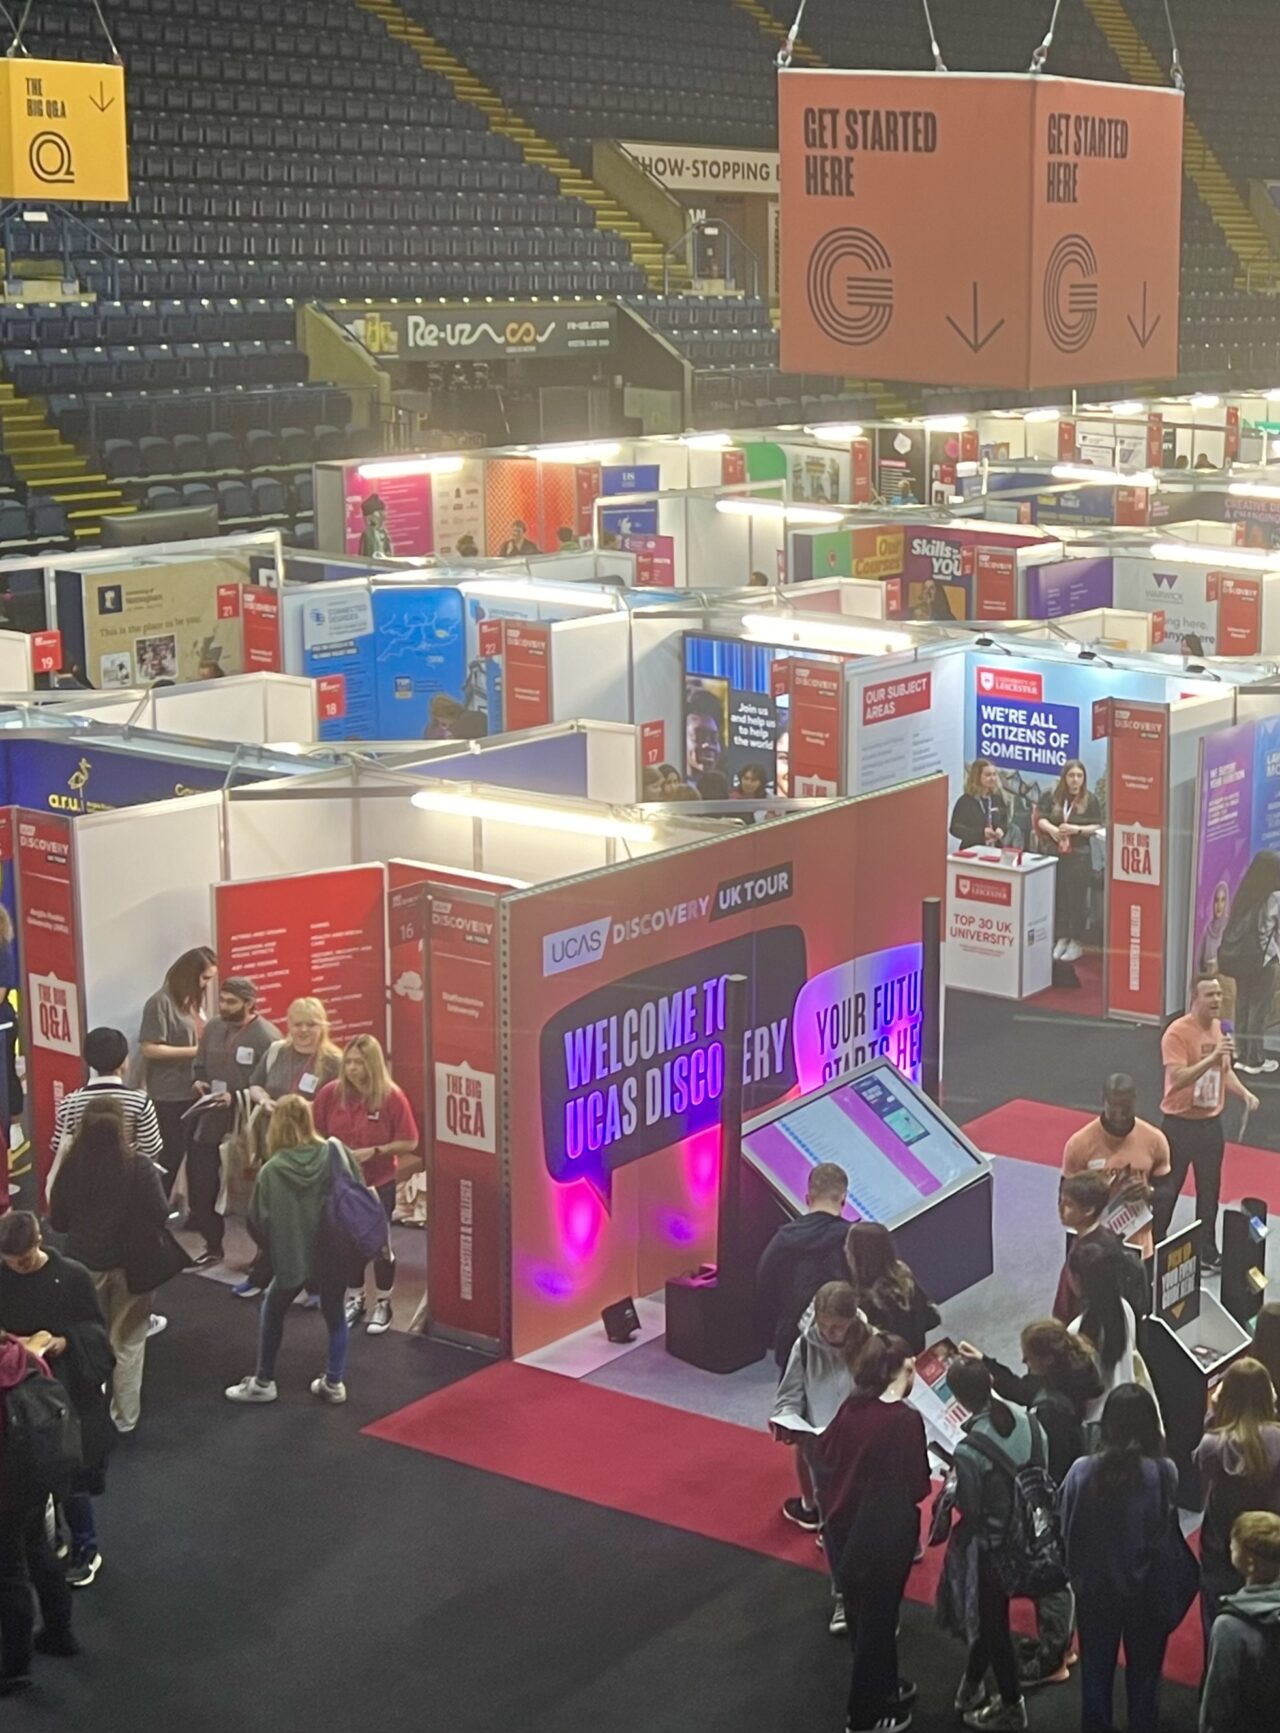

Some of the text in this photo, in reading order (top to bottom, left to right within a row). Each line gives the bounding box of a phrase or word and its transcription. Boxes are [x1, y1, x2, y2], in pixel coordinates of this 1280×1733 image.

[26, 77, 43, 96] THE
[27, 98, 66, 119] BIG Q&A
[803, 107, 937, 153] GET STARTED
[1048, 113, 1129, 159] GET STARTED
[805, 155, 855, 198] HERE
[1046, 162, 1079, 203] HERE
[807, 227, 893, 346] G
[1043, 234, 1098, 354] G
[1224, 498, 1268, 512] CREATIVE
[878, 538, 901, 557] Our
[911, 538, 952, 560] Skills
[855, 557, 901, 577] Courses
[932, 557, 962, 577] YOU
[1145, 589, 1184, 601] WARWICK
[99, 627, 118, 638] This
[128, 623, 142, 633] the
[142, 621, 164, 636] place
[41, 656, 54, 669] 19
[865, 677, 928, 705] OUR SUBJECT
[995, 682, 1038, 695] LEICESTER
[325, 703, 337, 716] 18
[738, 703, 769, 716] Join us
[865, 700, 896, 720] AREAS
[981, 705, 1058, 730] WE'RE ALL
[730, 712, 776, 729] and help us
[1114, 719, 1162, 732] DISCOVERY
[738, 725, 769, 740] to help
[981, 723, 1069, 749] CITIZENS OF
[733, 736, 774, 751] the world
[981, 740, 1067, 766] SOMETHING
[647, 749, 659, 763] 17
[20, 835, 69, 854] DISCOVERY
[1122, 830, 1150, 849] THE BIG
[1120, 846, 1152, 876] Q&A
[431, 912, 494, 937] DISCOVERY
[552, 871, 789, 964] UCAS DISCOVERY UK TOUR
[953, 913, 976, 927] TOP
[978, 918, 994, 930] 30
[996, 921, 1013, 934] UK
[399, 922, 415, 941] 16
[950, 926, 1015, 948] UNIVERSITY
[38, 982, 67, 1008] THE BIG
[39, 1007, 72, 1044] Q&A
[816, 992, 866, 1056] YOUR
[563, 986, 697, 1091] WELCOME
[446, 1072, 482, 1100] THE BIG
[564, 1015, 788, 1160] UCAS DISCOERY
[446, 1093, 487, 1139] Q&A
